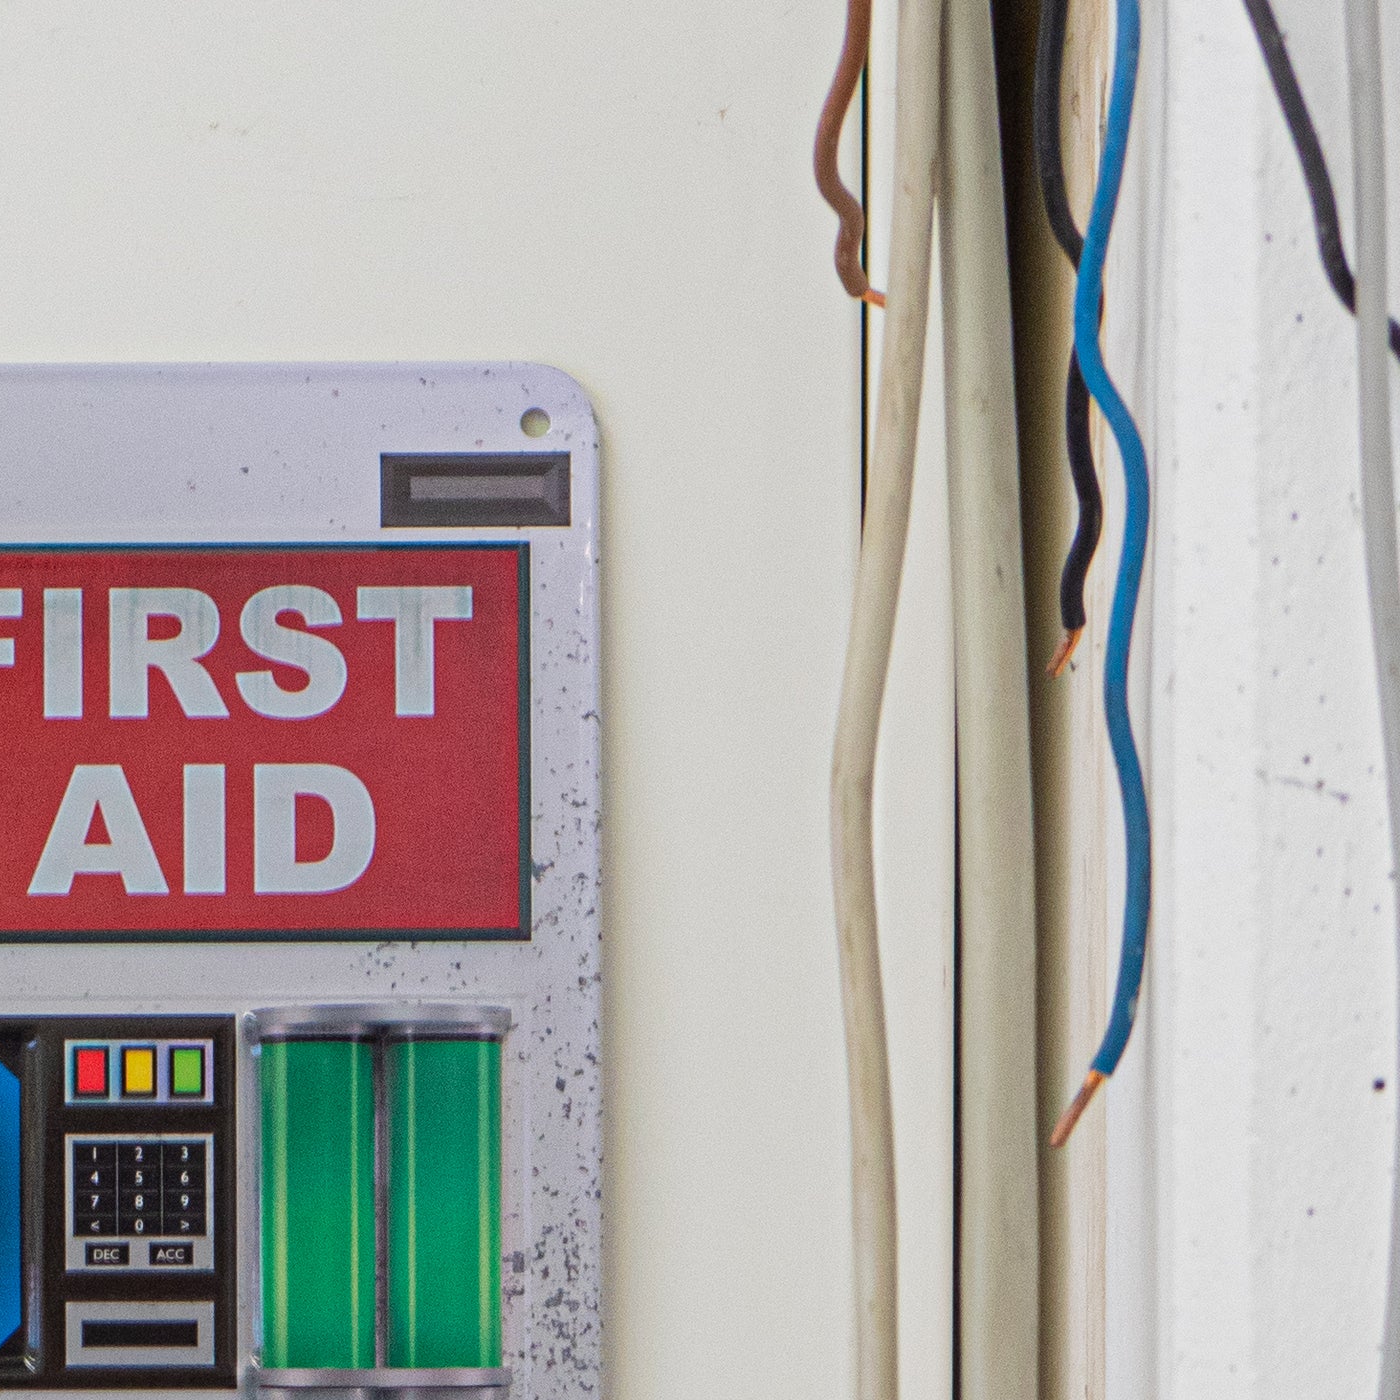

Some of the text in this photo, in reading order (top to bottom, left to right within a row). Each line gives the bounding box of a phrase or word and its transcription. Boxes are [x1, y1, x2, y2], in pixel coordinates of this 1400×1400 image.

[26, 763, 377, 897] AID
[92, 1145, 189, 1160] 1 2 3
[90, 1170, 189, 1184] 4 5 6
[91, 1194, 190, 1208] 7 8 9
[134, 1218, 144, 1232] 0
[93, 1248, 185, 1261] DEC ACC
